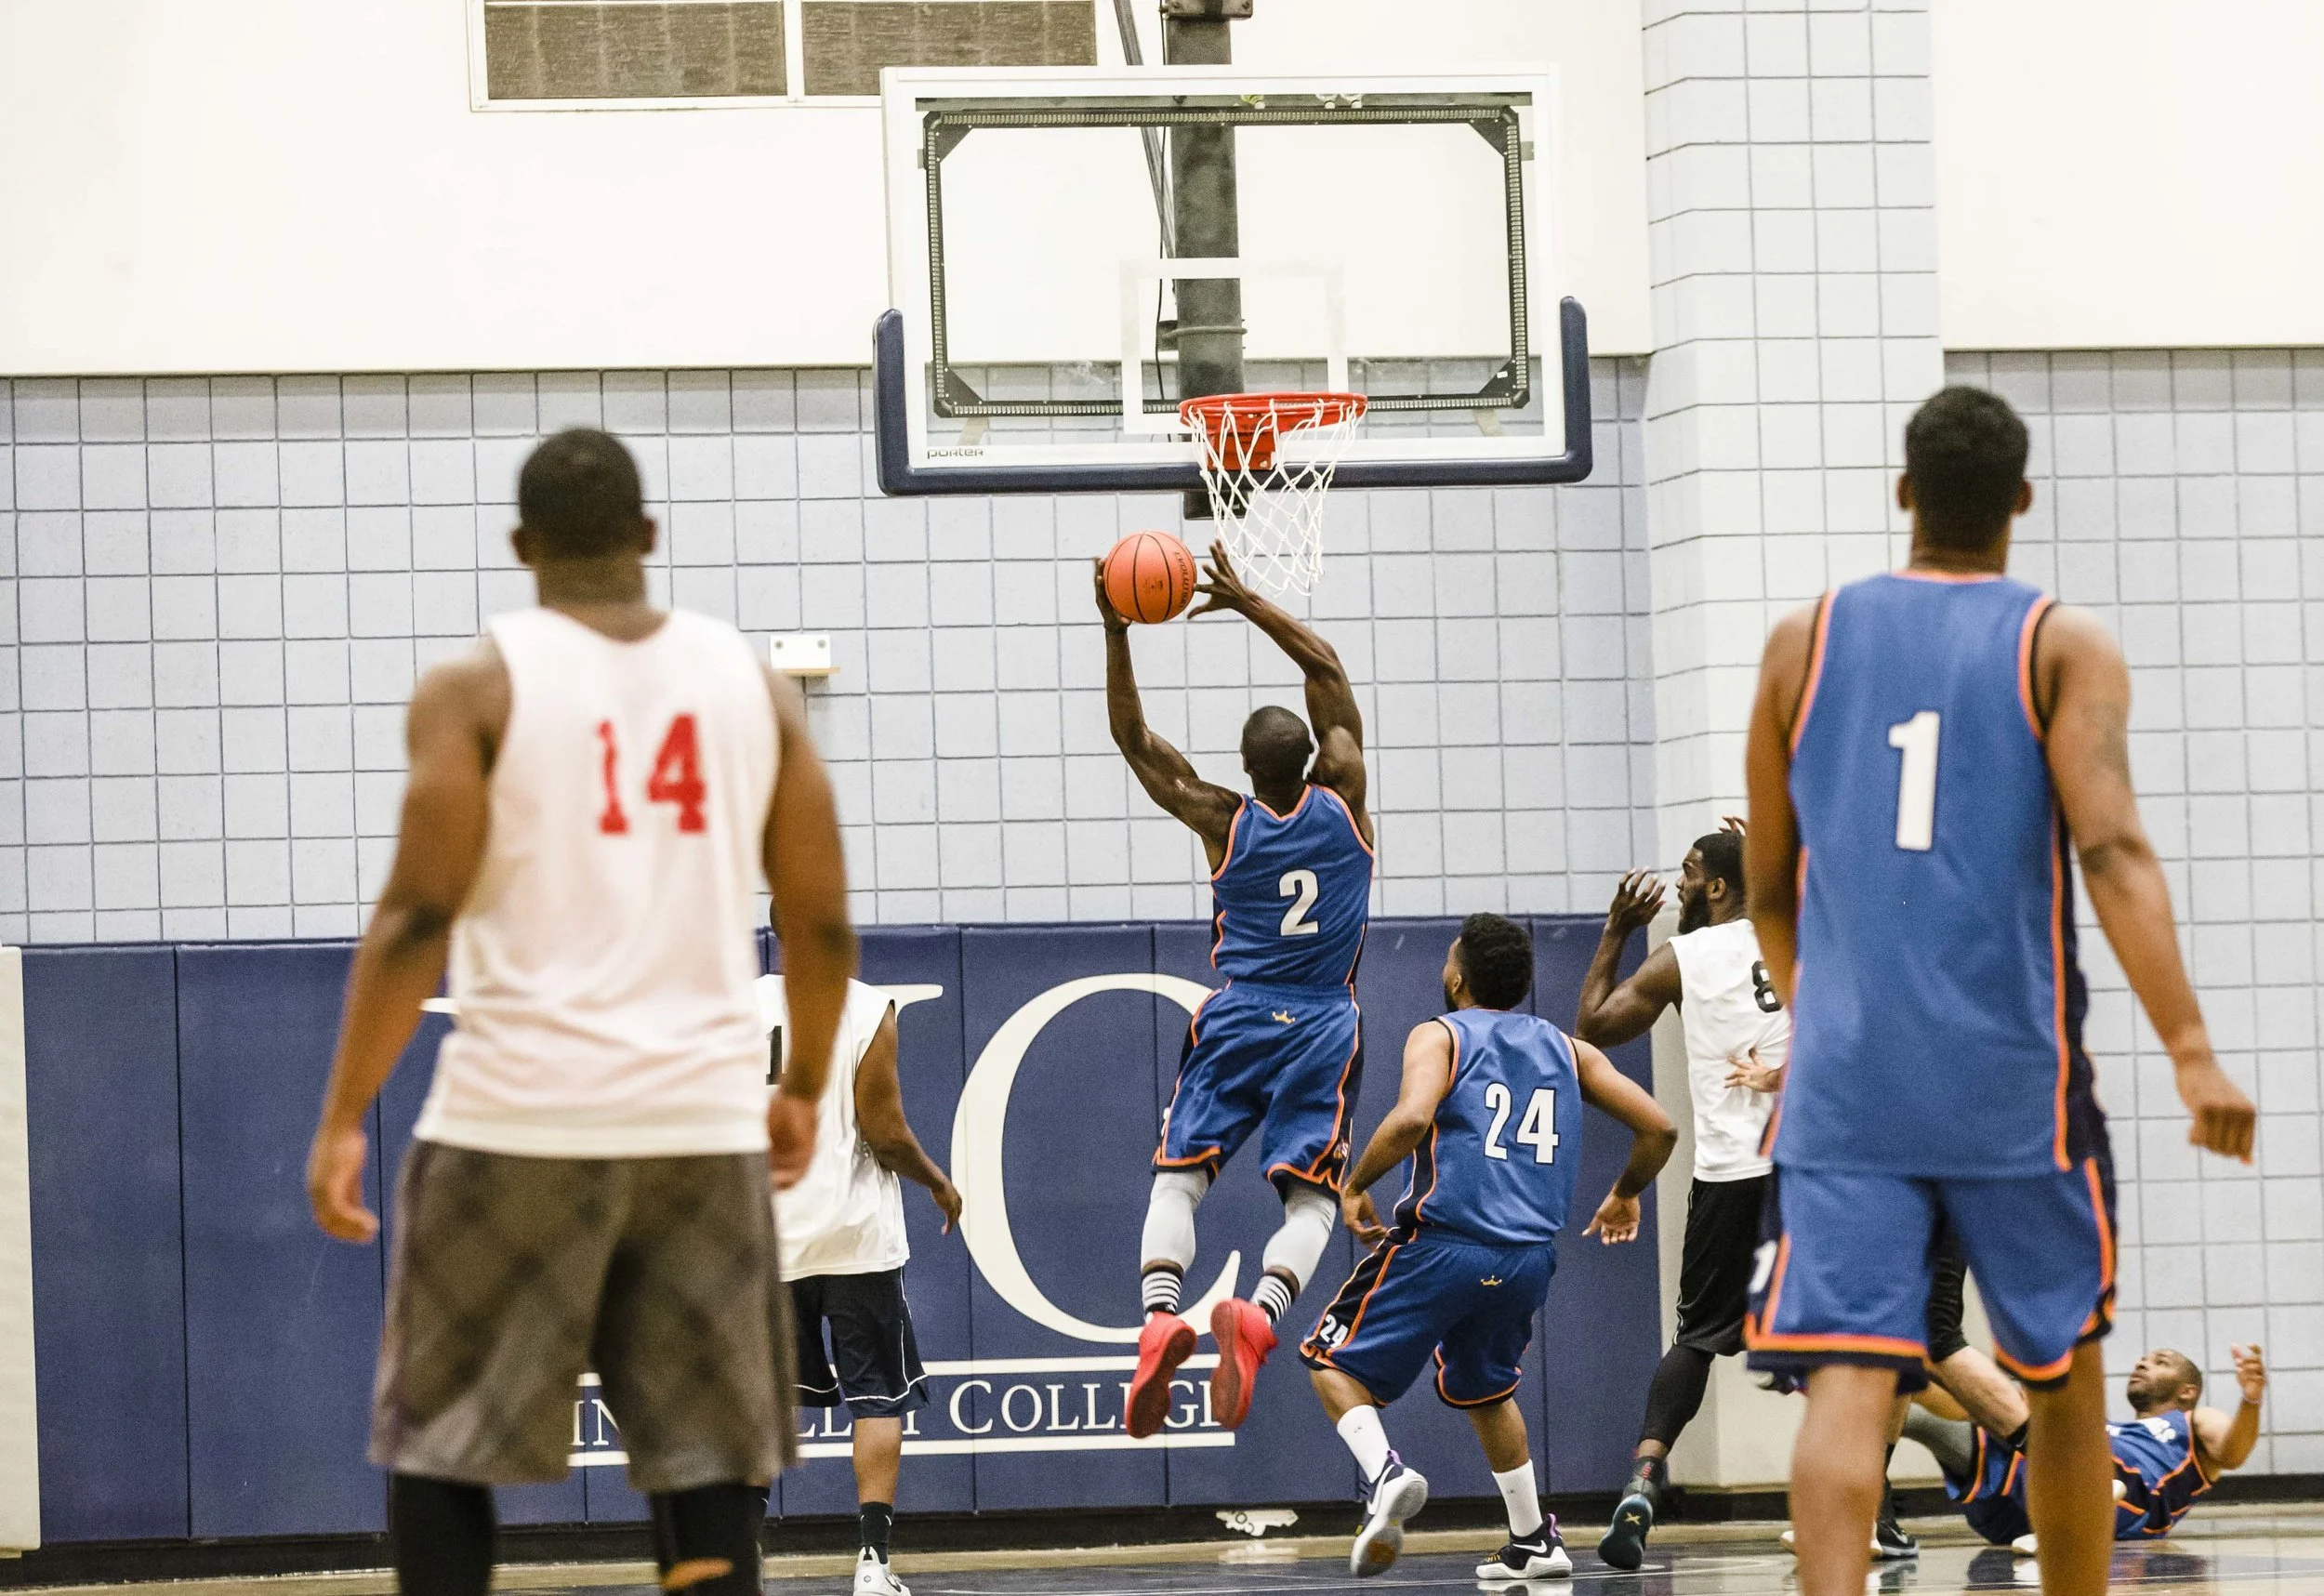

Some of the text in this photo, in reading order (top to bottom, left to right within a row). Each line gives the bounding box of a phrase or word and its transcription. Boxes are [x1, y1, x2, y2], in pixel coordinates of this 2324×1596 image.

[597, 713, 707, 836] 14
[1888, 710, 1940, 851] 1
[1278, 868, 1319, 937] 2
[765, 1025, 786, 1086] 1
[1485, 1082, 1559, 1164] 24
[1319, 1313, 1349, 1349] 24
[948, 1379, 1222, 1434] COLLG
